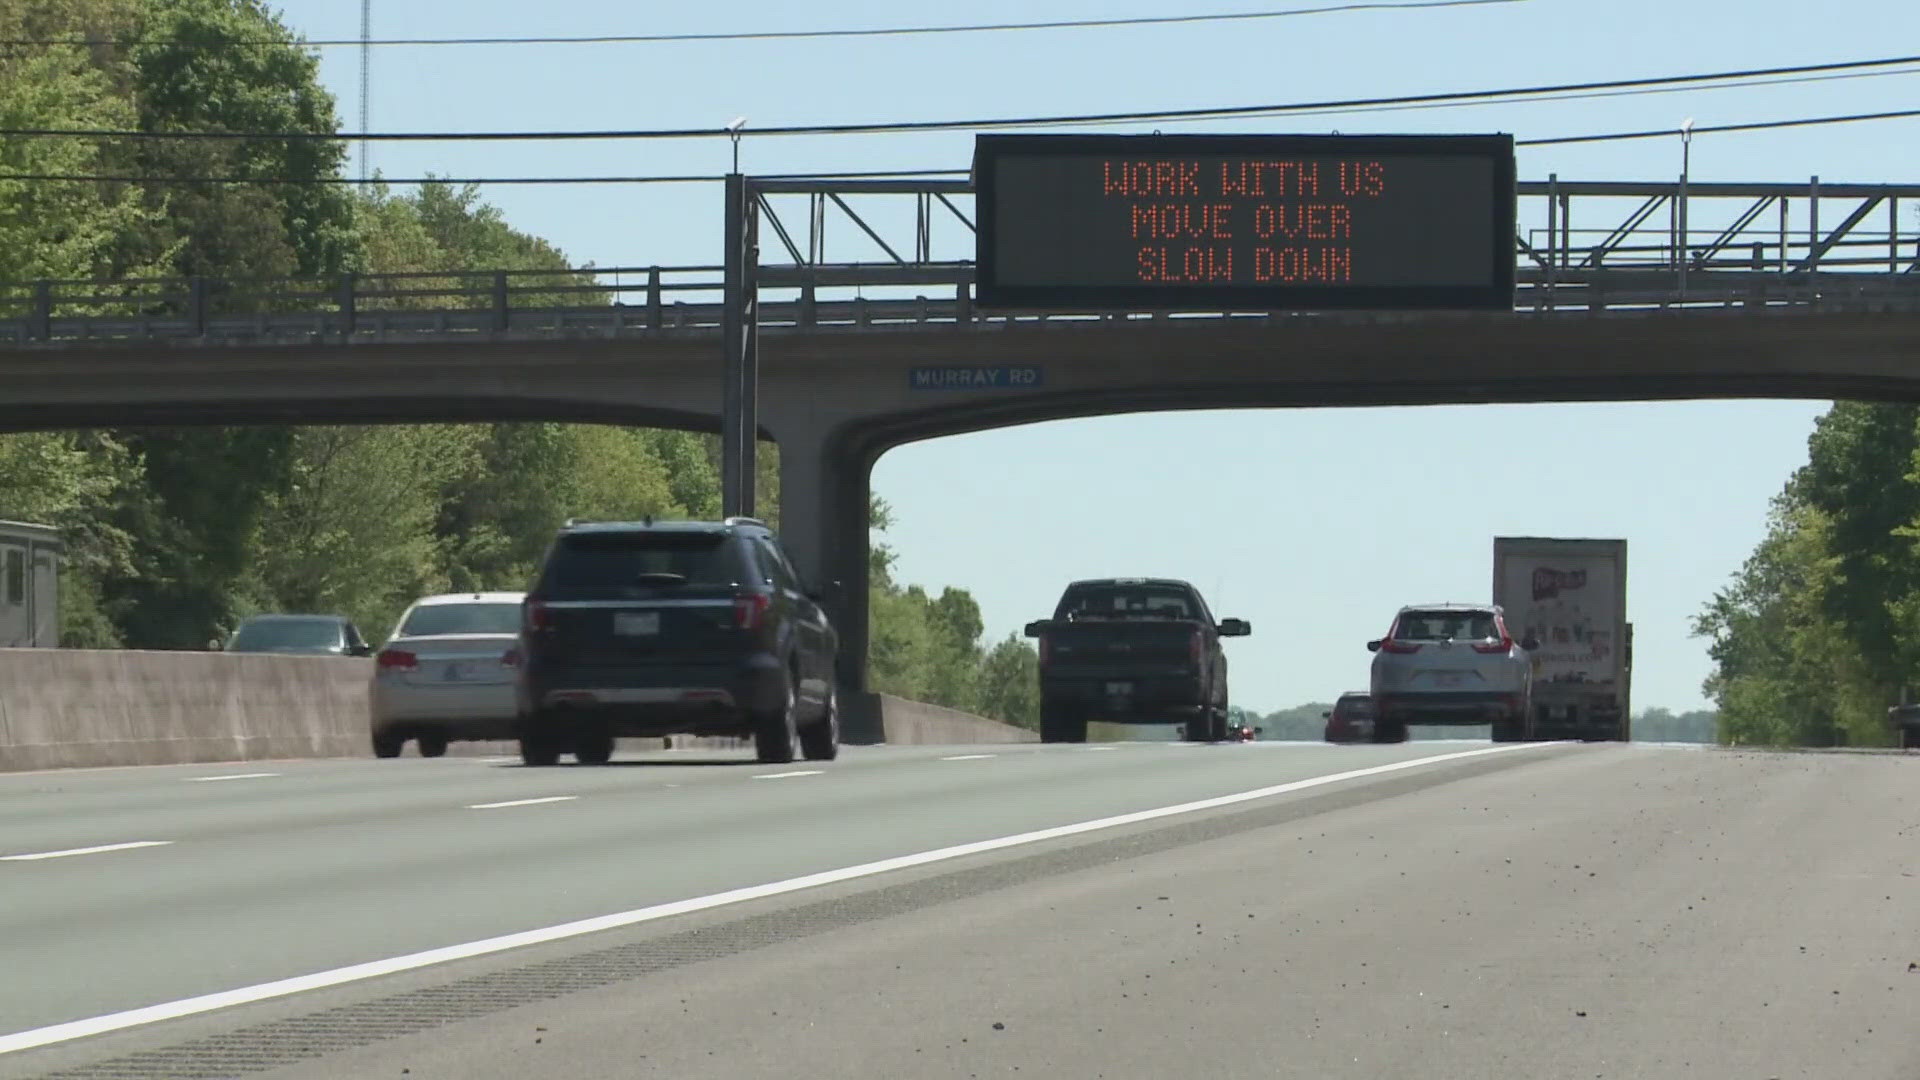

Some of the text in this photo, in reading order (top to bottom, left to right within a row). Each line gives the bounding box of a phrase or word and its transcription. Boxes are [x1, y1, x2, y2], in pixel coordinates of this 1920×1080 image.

[1103, 161, 1385, 196] WORK WITH US
[1131, 204, 1351, 239] MOVE OVER
[1137, 247, 1351, 282] SLOW DOWN
[916, 368, 1037, 385] MURRAY RD
